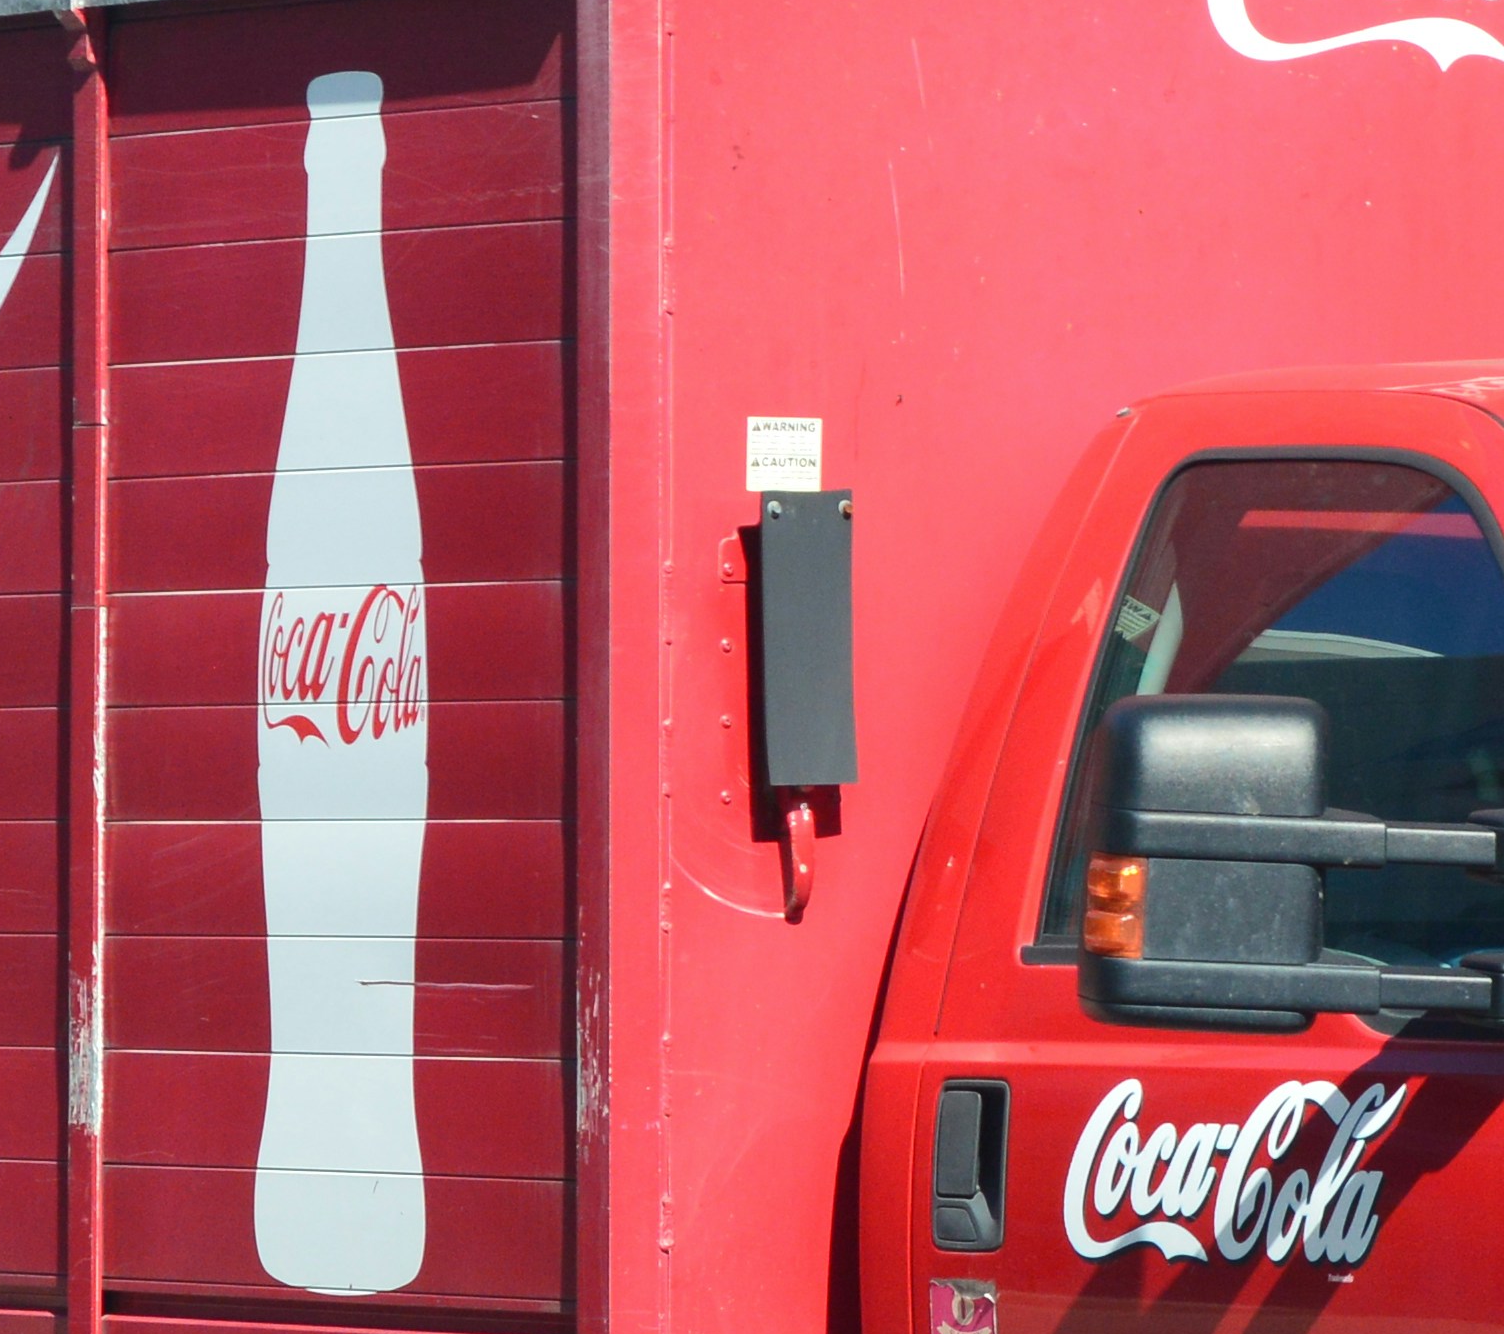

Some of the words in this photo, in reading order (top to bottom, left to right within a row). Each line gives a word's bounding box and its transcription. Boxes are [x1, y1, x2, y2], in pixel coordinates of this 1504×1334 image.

[761, 457, 817, 468] CAUTION
[762, 422, 816, 433] WARNING
[262, 583, 424, 749] Coca-Cola
[1063, 1078, 1407, 1264] Coca-Cola
